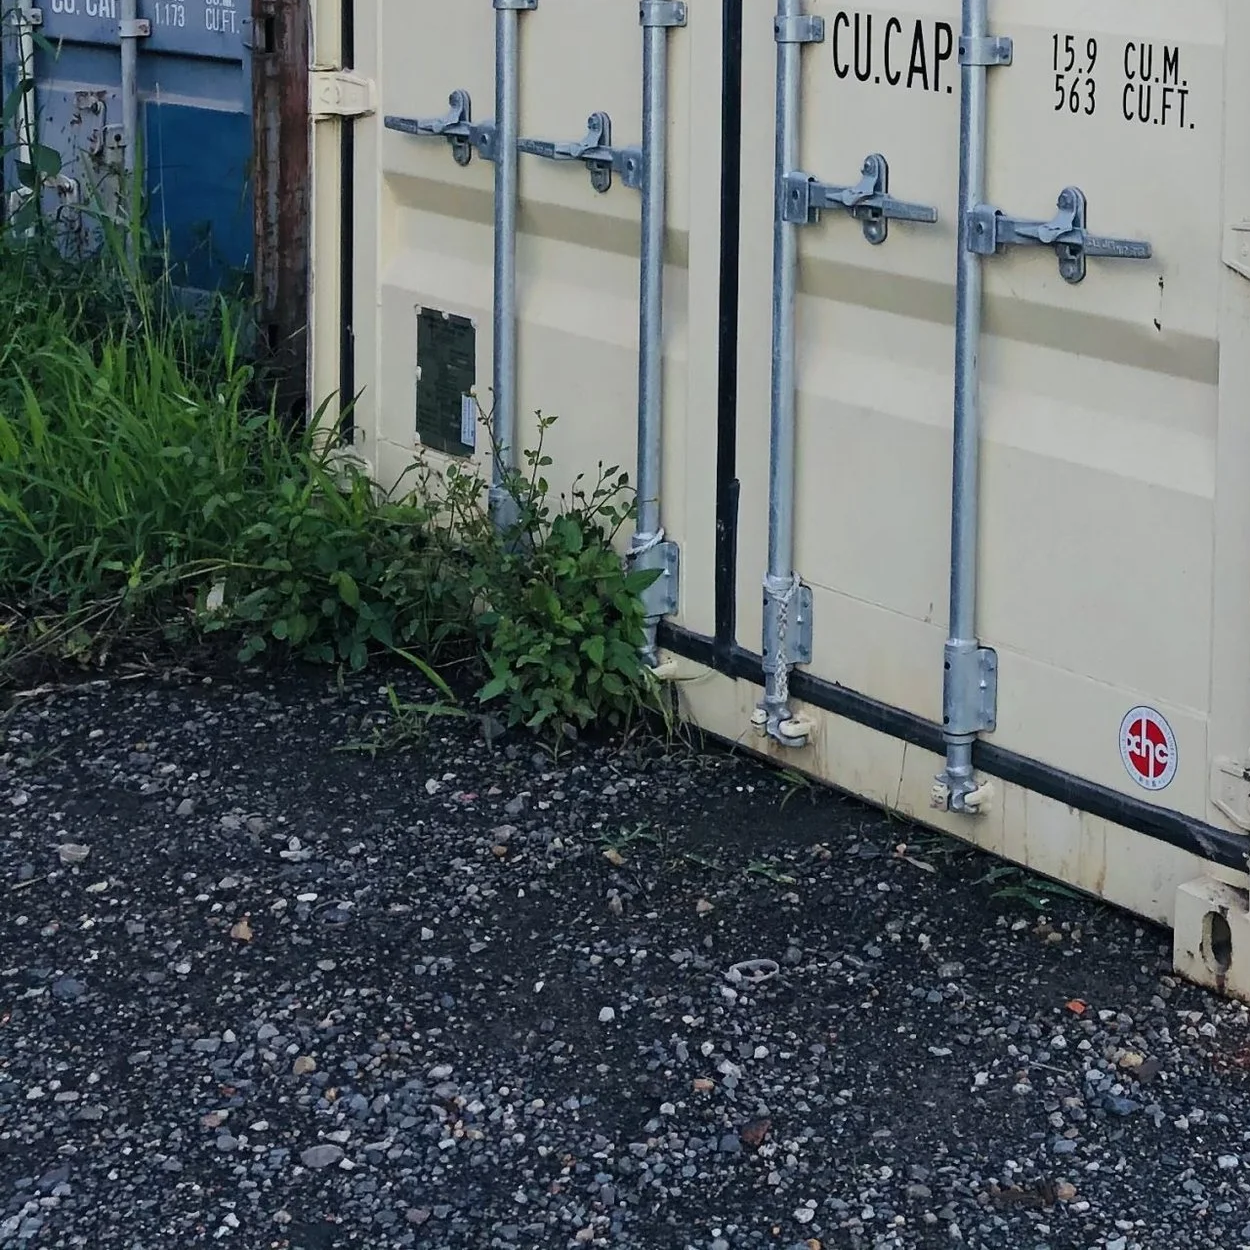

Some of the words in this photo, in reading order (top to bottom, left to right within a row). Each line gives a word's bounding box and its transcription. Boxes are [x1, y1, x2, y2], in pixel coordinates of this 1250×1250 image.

[155, 4, 185, 28] 1.173
[833, 12, 953, 93] CU.CAP.
[1052, 34, 1097, 74] 15.9
[1124, 43, 1187, 86] CU.M.
[1055, 74, 1096, 115] 563
[1122, 83, 1195, 129] CU.FT.
